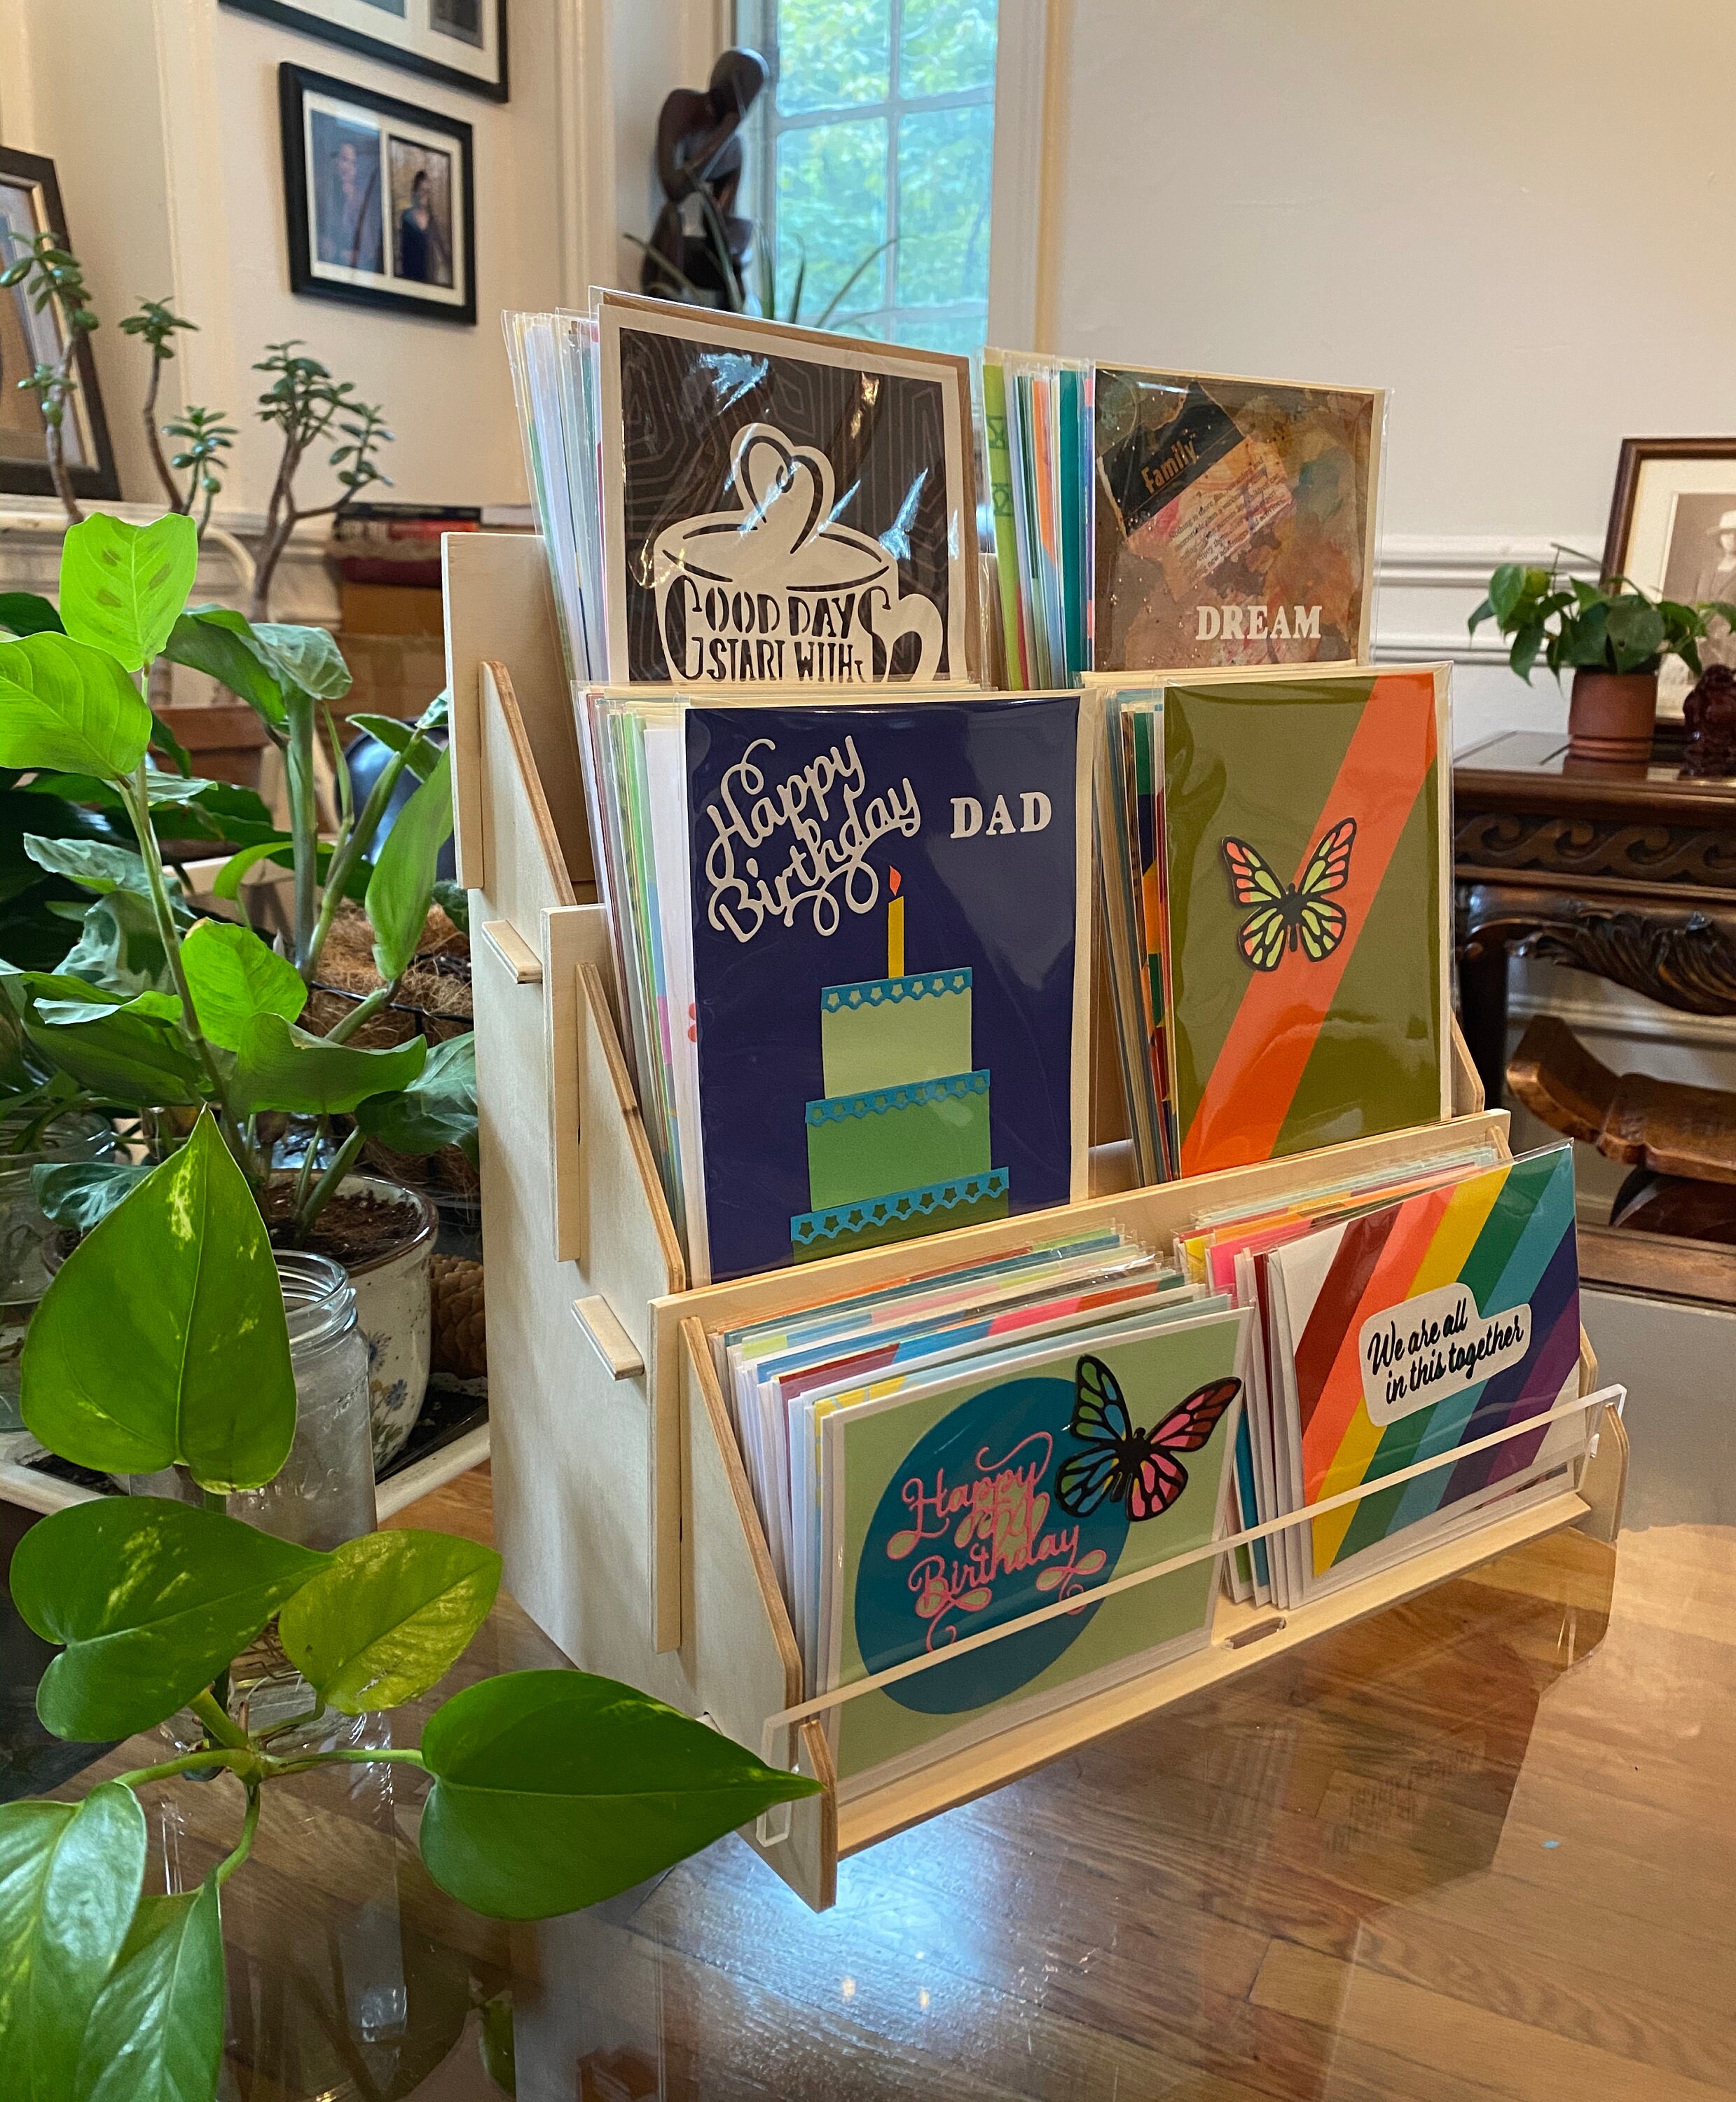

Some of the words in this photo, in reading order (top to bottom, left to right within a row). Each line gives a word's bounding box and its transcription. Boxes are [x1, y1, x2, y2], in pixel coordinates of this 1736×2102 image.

[1141, 440, 1197, 494] Family
[665, 575, 780, 680] GOOD
[787, 586, 891, 682] DAYS
[706, 638, 786, 680] START
[795, 641, 853, 682] WITH
[1196, 605, 1322, 640] DREAM
[706, 735, 865, 848] Happy
[950, 792, 1052, 839] DAD
[706, 778, 921, 942] Birthday
[1367, 1320, 1405, 1375] We
[1408, 1319, 1441, 1356] are
[1442, 1298, 1468, 1338] all
[1386, 1370, 1407, 1405] in
[1410, 1349, 1447, 1392] this
[1448, 1314, 1524, 1380] together
[888, 1431, 1052, 1558] Happy
[908, 1525, 1107, 1647] Birthday
